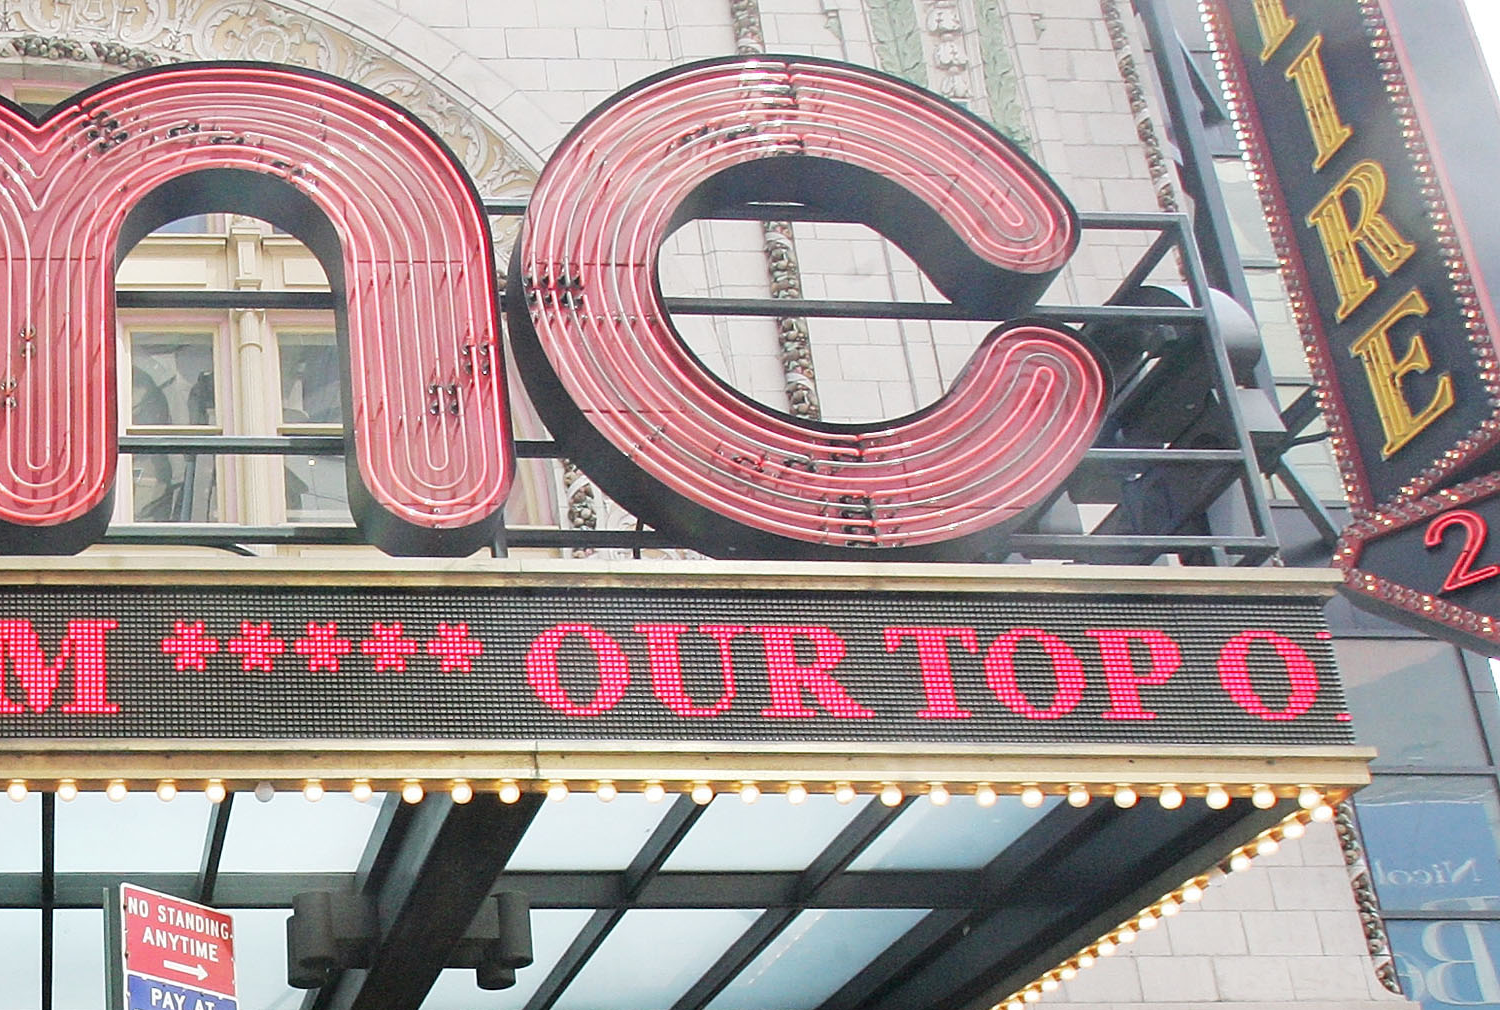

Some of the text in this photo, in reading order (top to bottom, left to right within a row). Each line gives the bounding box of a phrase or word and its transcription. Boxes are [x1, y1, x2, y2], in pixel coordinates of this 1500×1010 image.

[1251, 0, 1455, 462] IRE
[1423, 508, 1500, 592] 2
[524, 622, 876, 721] OUR
[883, 626, 1183, 721] TOP
[1217, 629, 1351, 722] O
[127, 896, 230, 940] NO STANDING
[142, 926, 220, 963] ANYTIME
